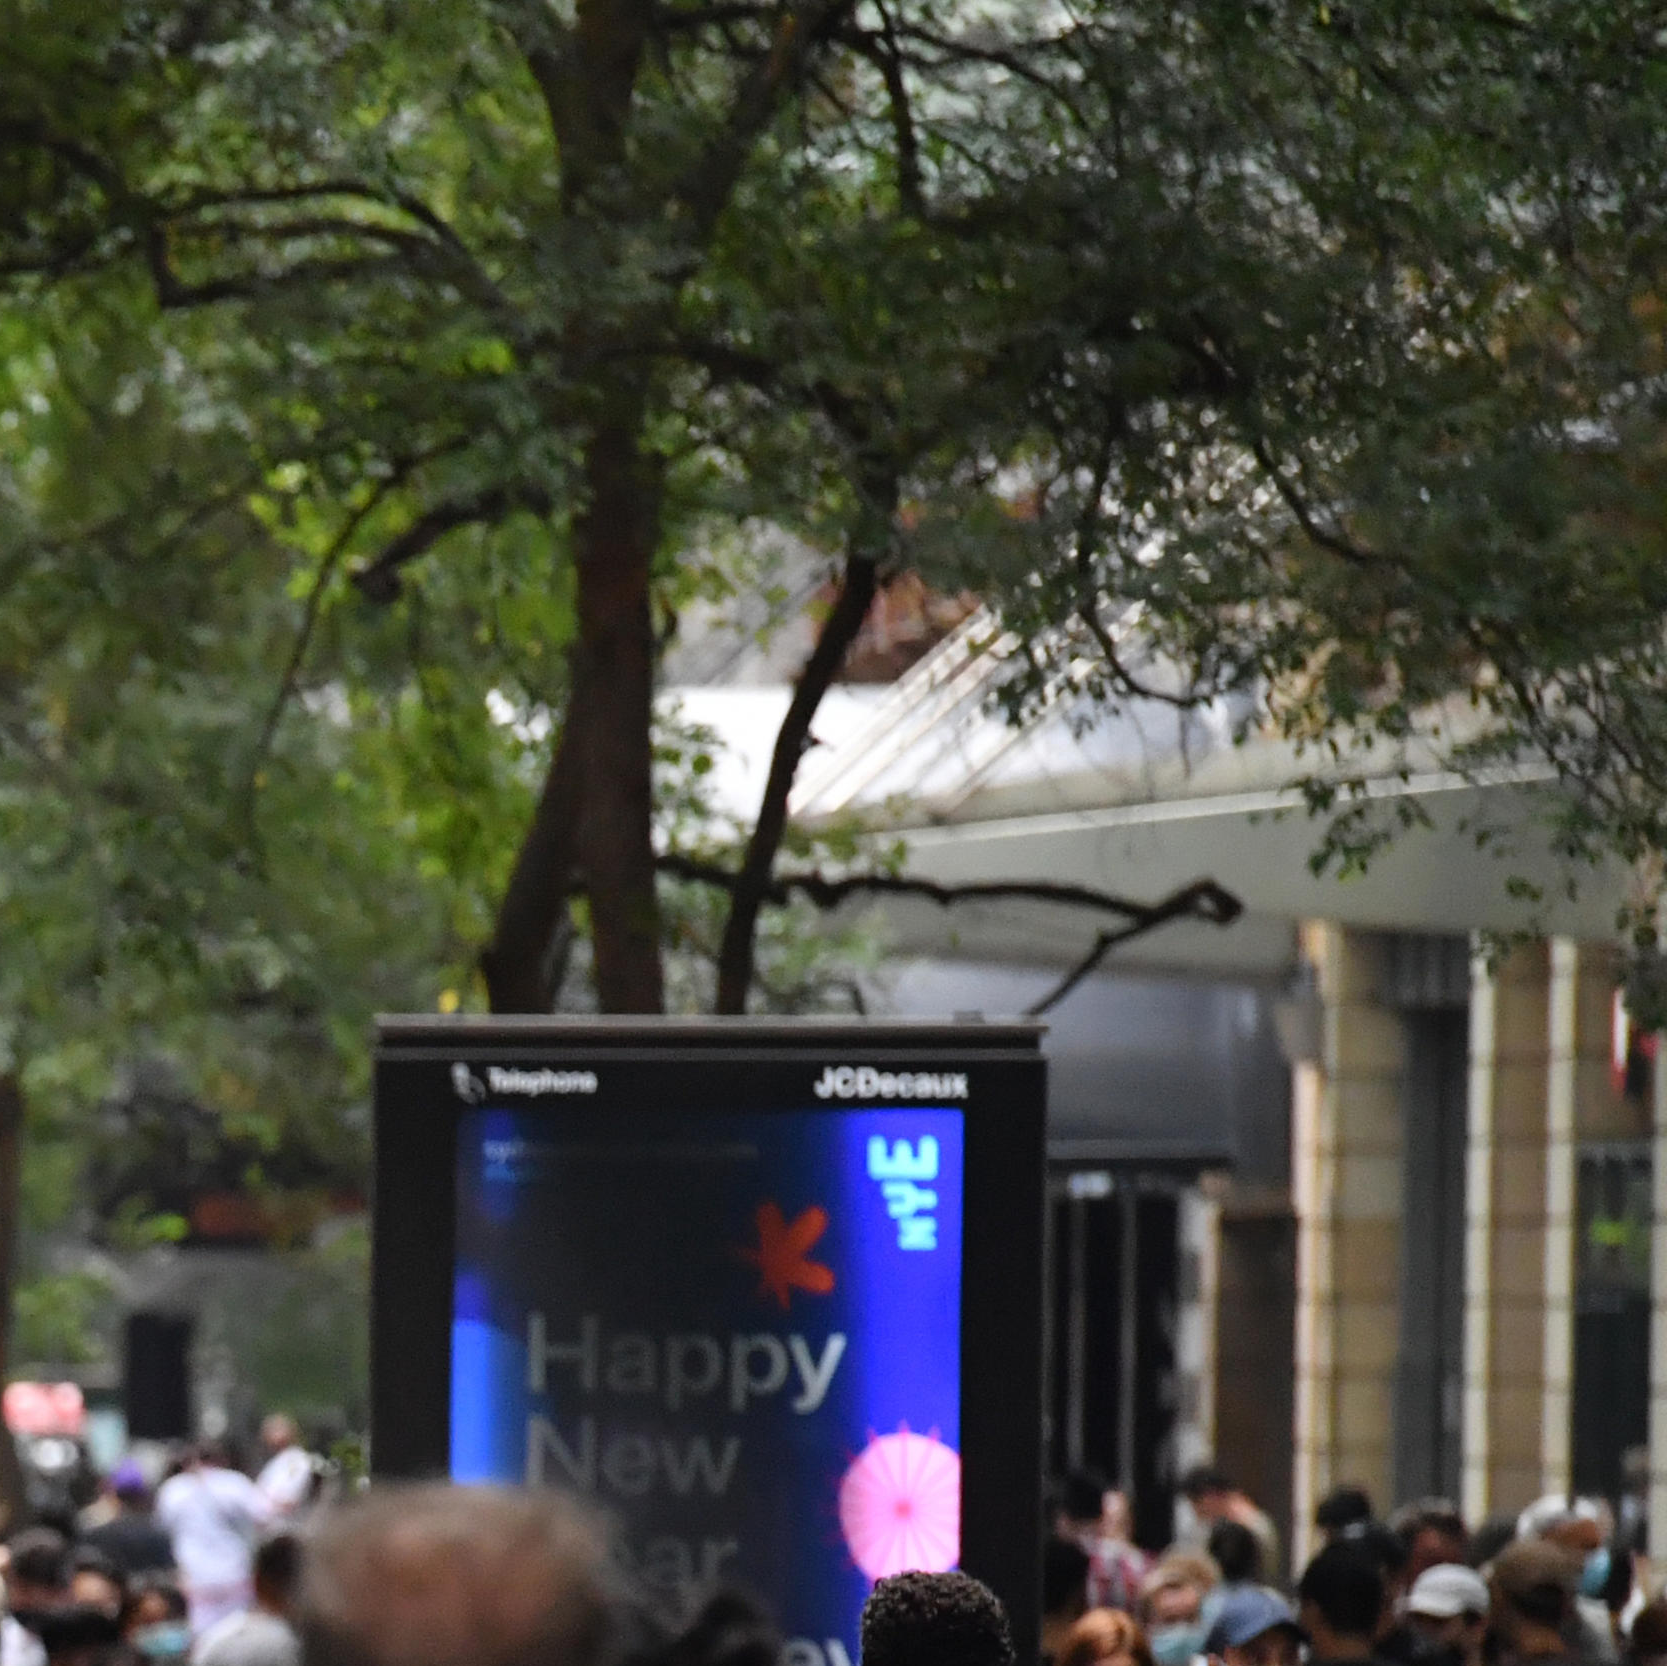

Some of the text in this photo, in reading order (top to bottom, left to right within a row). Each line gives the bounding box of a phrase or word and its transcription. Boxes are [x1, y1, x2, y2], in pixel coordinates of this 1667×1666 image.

[485, 1065, 599, 1097] Telephone
[813, 1065, 969, 1100] JCDecaux
[867, 1134, 939, 1252] NYE
[525, 1310, 848, 1416] Happy
[525, 1411, 742, 1498] New
